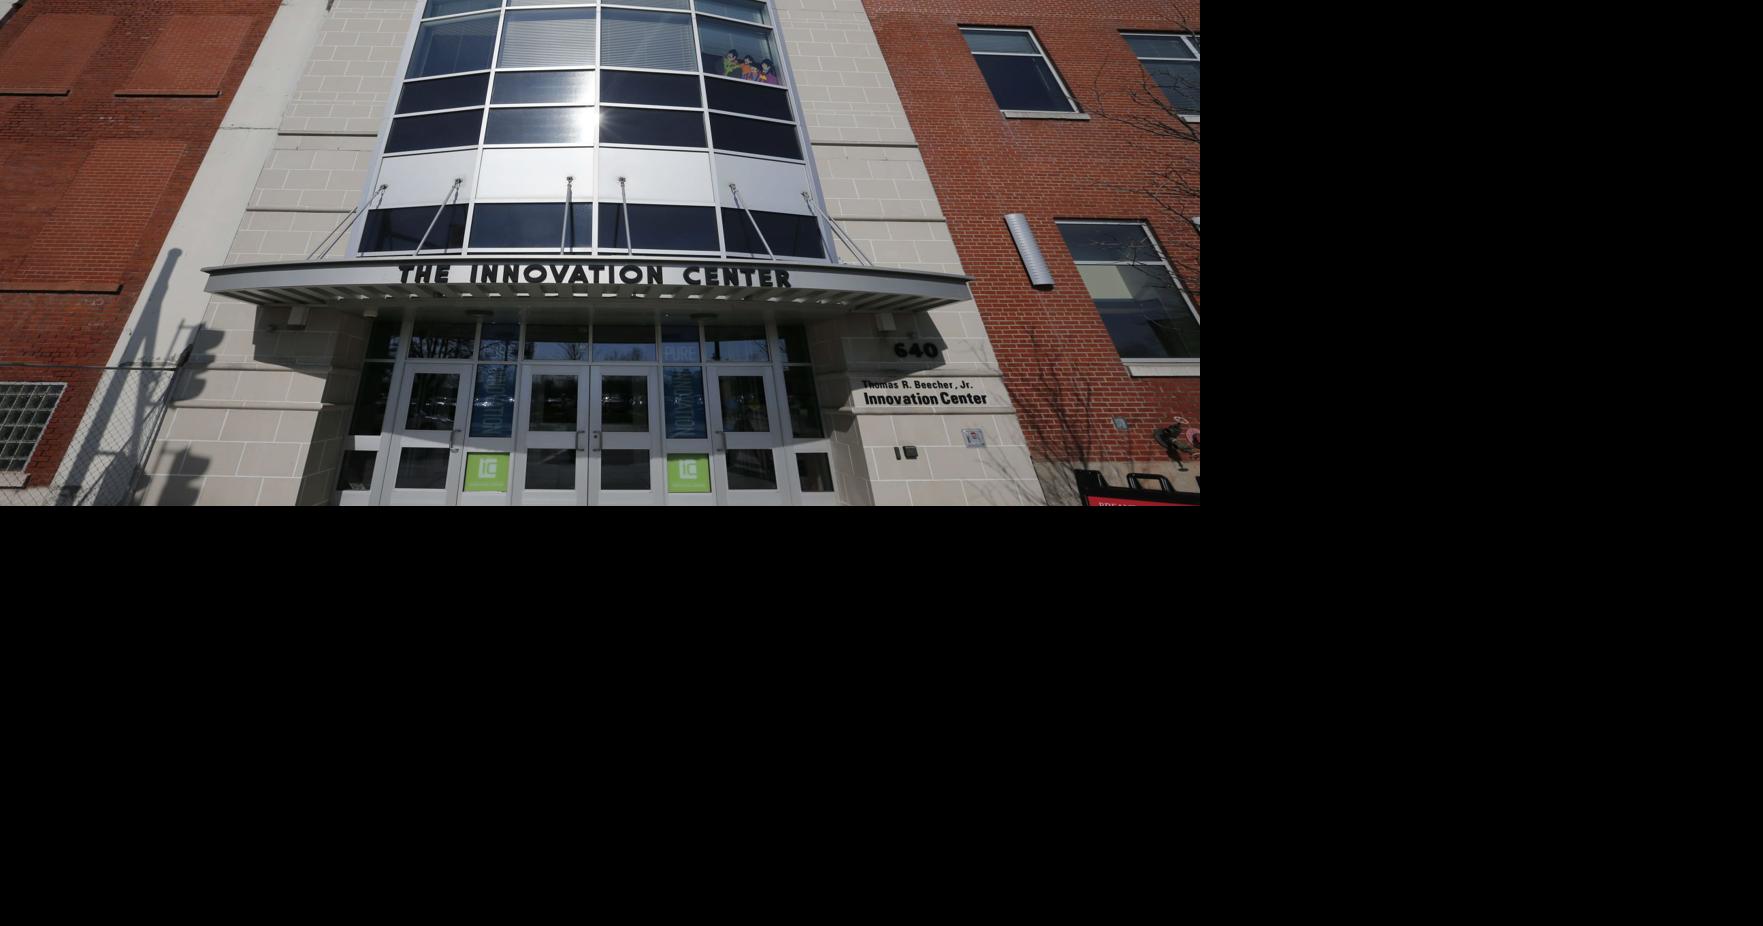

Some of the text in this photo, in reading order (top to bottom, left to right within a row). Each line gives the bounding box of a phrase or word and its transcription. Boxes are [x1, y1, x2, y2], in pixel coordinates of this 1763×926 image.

[399, 264, 793, 289] THE INNOVATION CENTER
[664, 346, 696, 361] PURE
[894, 342, 938, 358] 640
[862, 380, 899, 389] Thomas
[902, 380, 912, 389] R.
[960, 380, 974, 389] Jr.
[864, 392, 988, 405] Innovation Center
